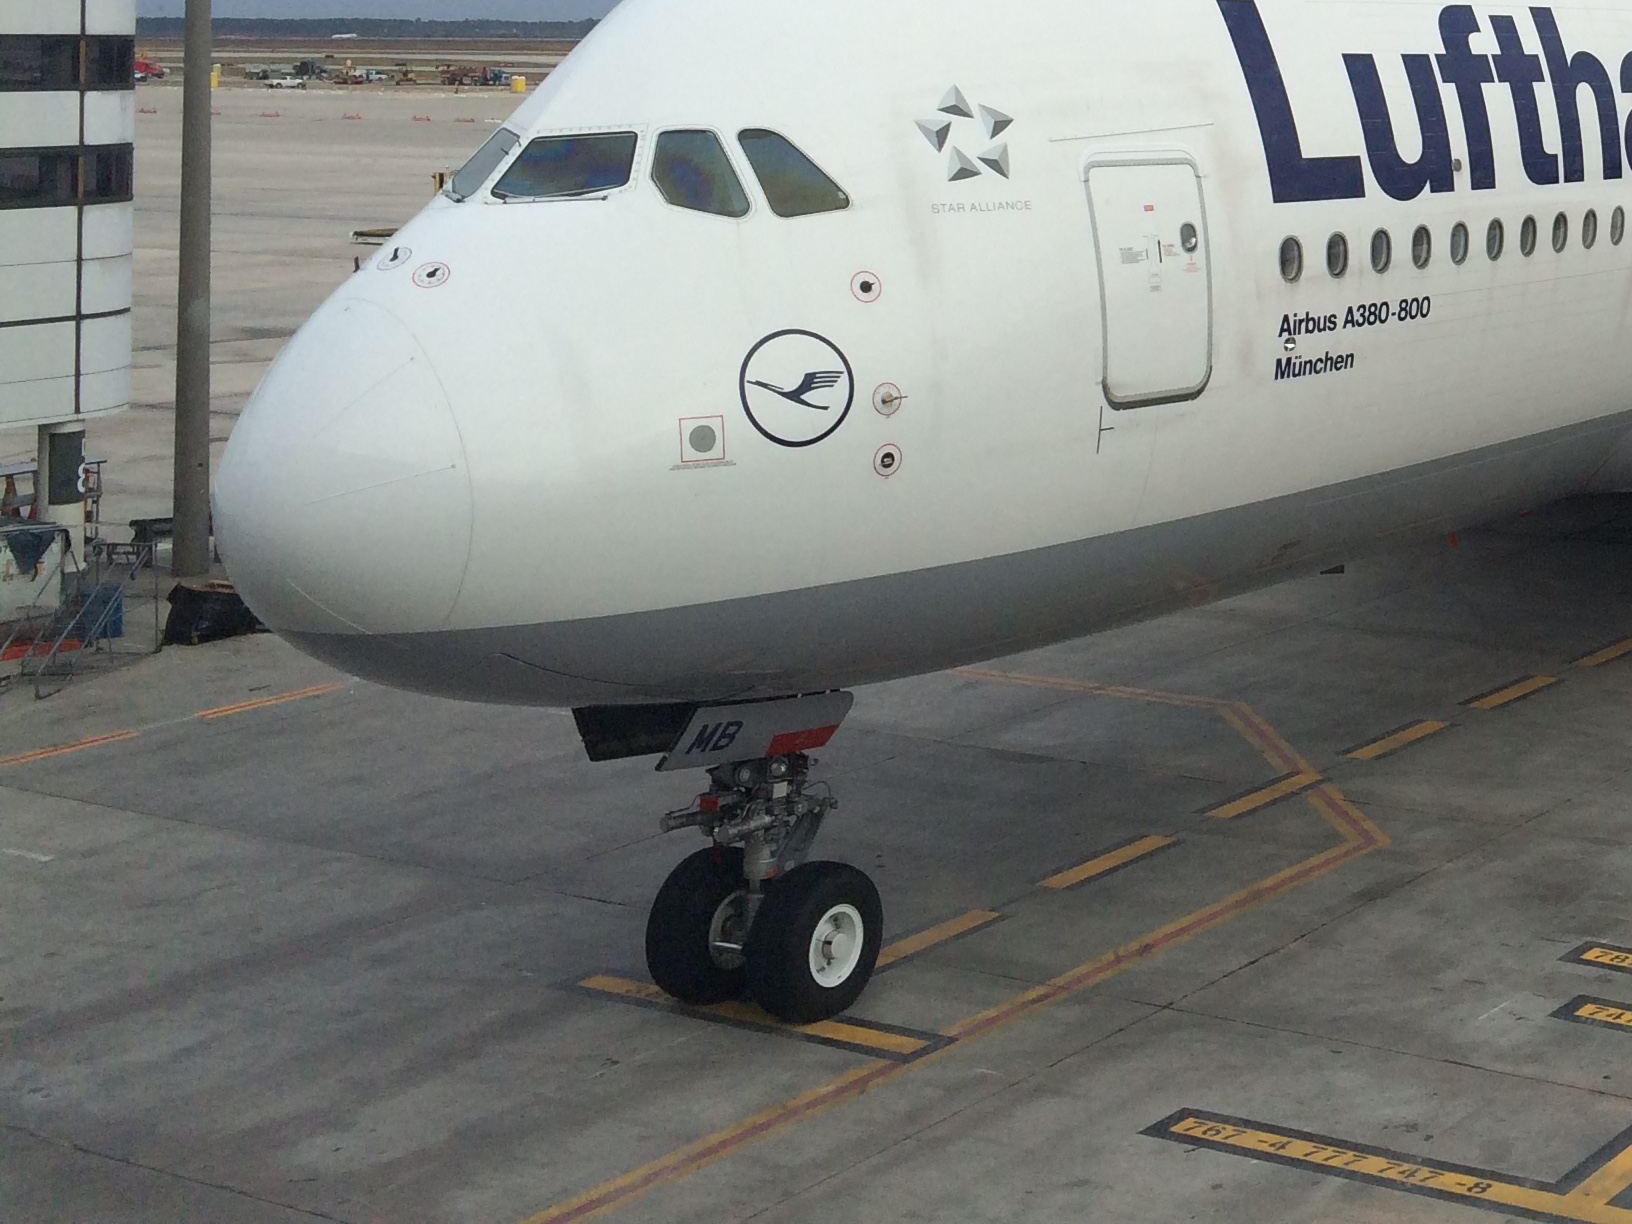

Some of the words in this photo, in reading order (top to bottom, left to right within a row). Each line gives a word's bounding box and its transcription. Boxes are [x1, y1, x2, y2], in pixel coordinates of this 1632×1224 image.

[931, 203, 966, 214] STAR
[970, 200, 1032, 212] ALLIANCE
[1278, 311, 1338, 337] Airbus
[1342, 295, 1431, 329] A380-800
[1273, 351, 1355, 380] München
[685, 720, 744, 755] MB
[1183, 1120, 1249, 1140] 767
[1256, 1137, 1292, 1152] -4
[1302, 1145, 1369, 1166] 777
[1376, 1161, 1445, 1184] 747
[1455, 1180, 1493, 1195] -8
